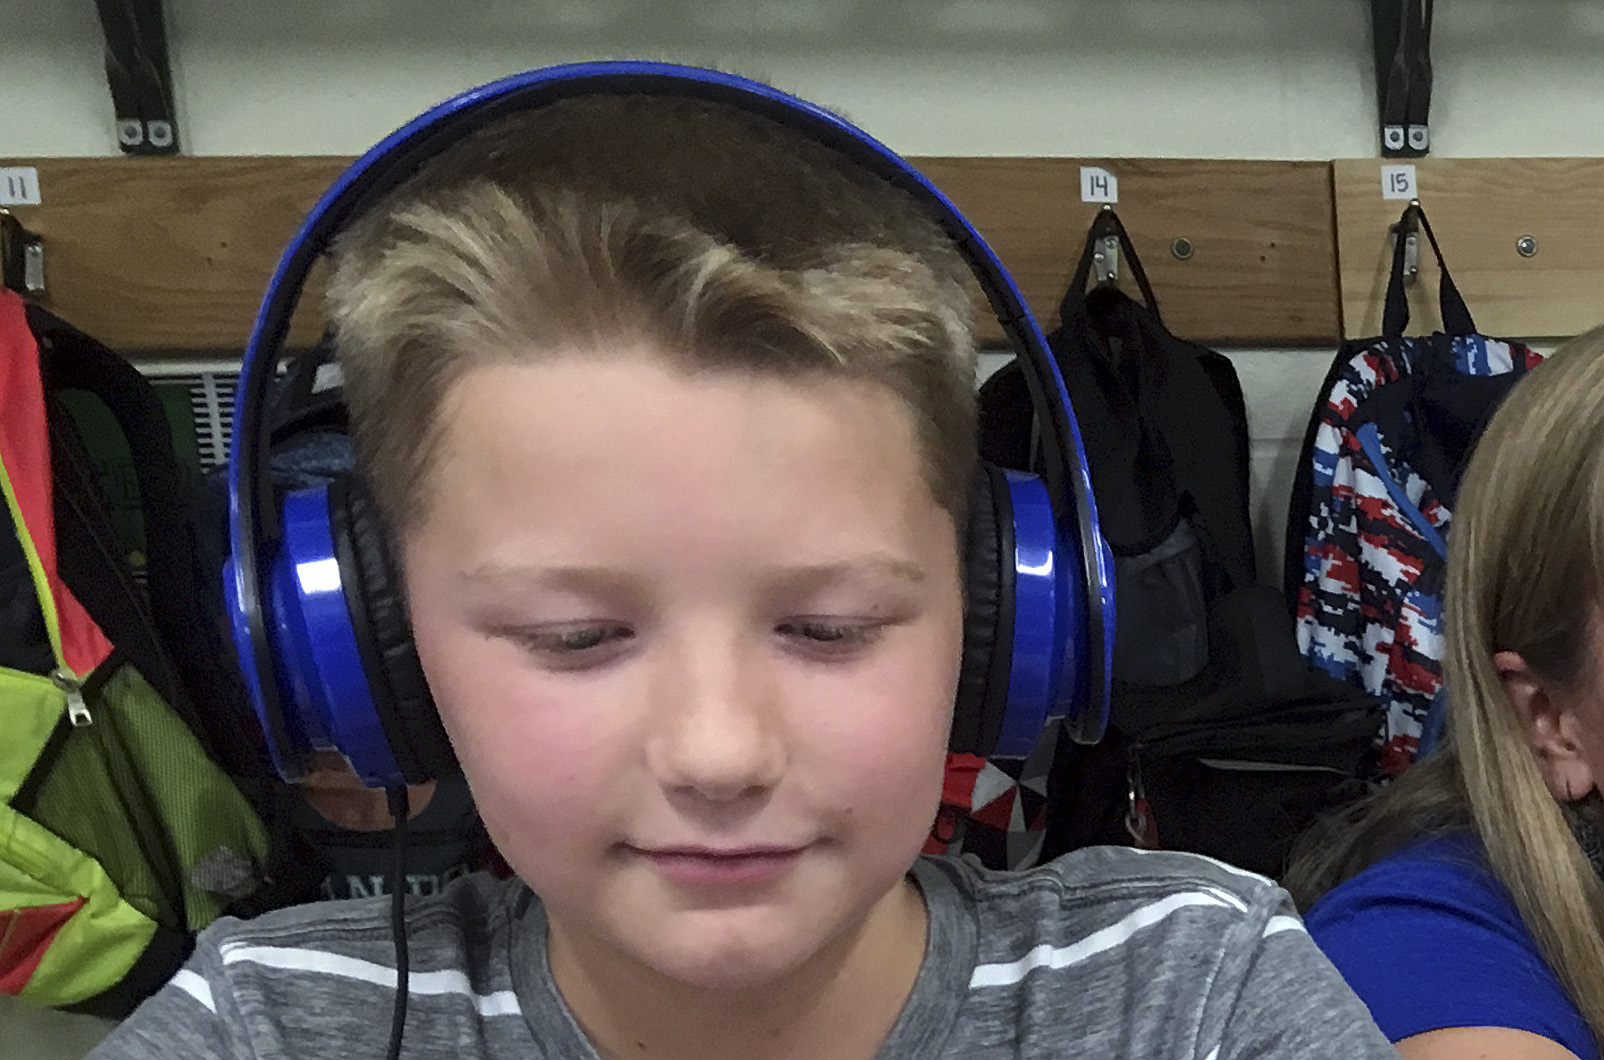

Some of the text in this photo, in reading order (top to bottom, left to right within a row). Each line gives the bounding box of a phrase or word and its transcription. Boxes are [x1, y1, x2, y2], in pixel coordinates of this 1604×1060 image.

[8, 177, 27, 199] 11
[1090, 174, 1108, 196] 14
[1390, 173, 1408, 192] 15
